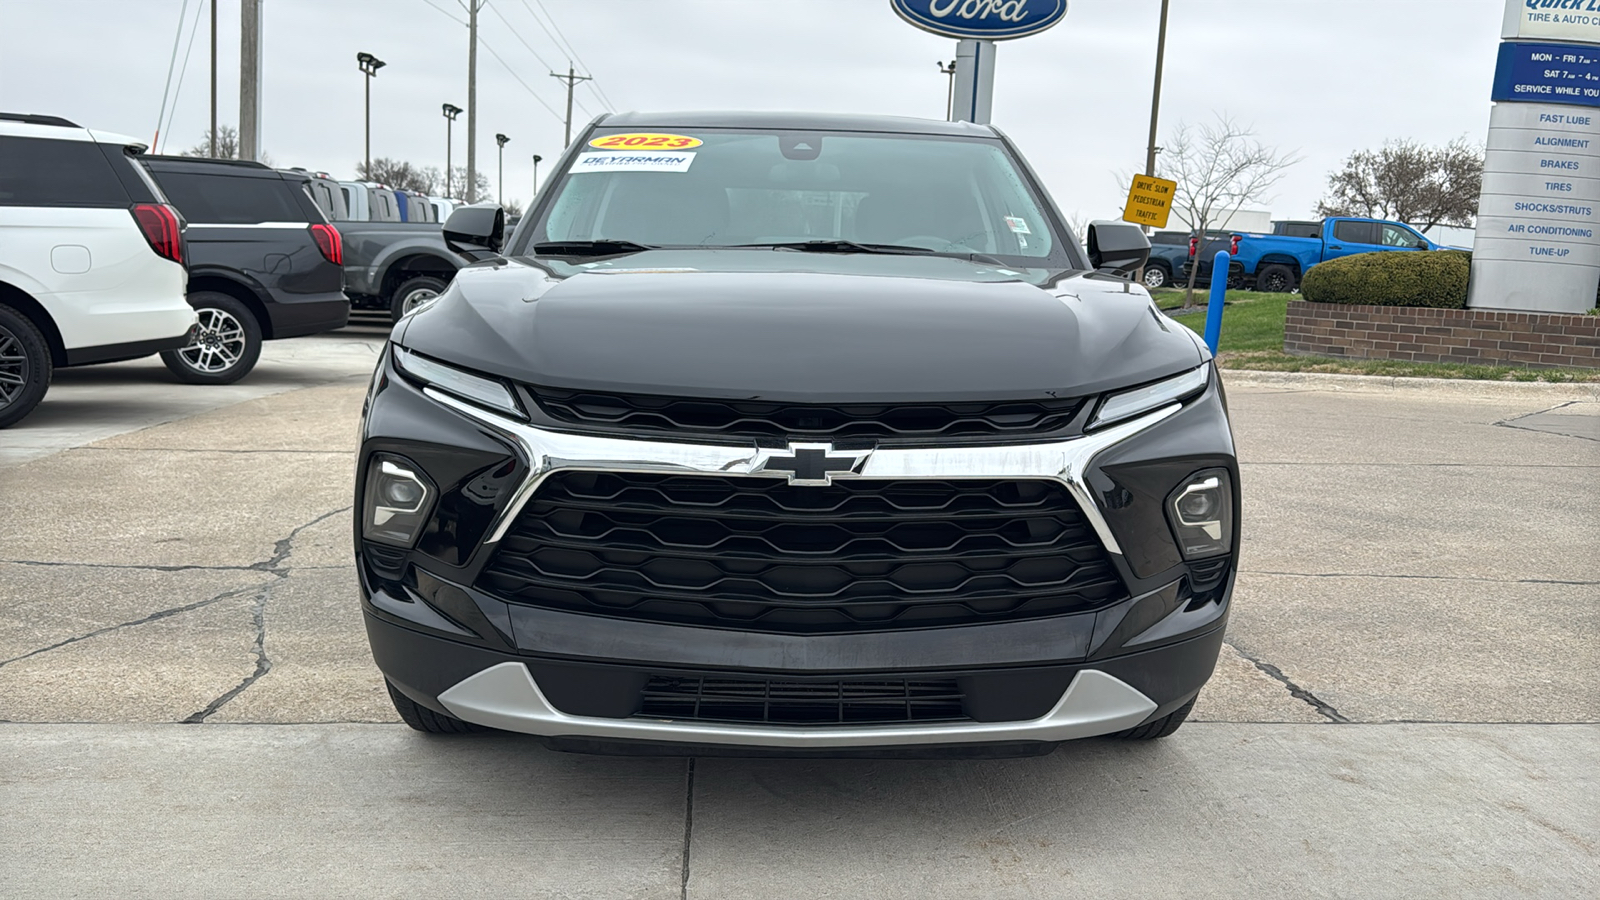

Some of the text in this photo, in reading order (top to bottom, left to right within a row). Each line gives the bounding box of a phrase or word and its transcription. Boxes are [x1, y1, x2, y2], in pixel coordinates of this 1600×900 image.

[1585, 0, 1600, 11] L
[1527, 13, 1600, 26] TIRE & AUTO C
[1531, 53, 1552, 61] MON
[1562, 54, 1576, 63] FRI
[1544, 70, 1560, 78] SAT
[1514, 84, 1600, 97] SERVICE WHILE YOU
[1540, 114, 1591, 125] FAST LUBE
[599, 136, 693, 147] 2023
[1534, 136, 1590, 149] ALIGNMENT
[582, 156, 687, 164] DEYARMAN
[1540, 159, 1579, 170] BRAKES
[1136, 181, 1169, 194] DRIVE SLOW
[1545, 182, 1572, 192] TIRES
[1133, 194, 1166, 207] PEDESTRIAN
[1136, 209, 1157, 220] TRAFFIC
[1514, 202, 1592, 216] SHOCKS/STRUTS
[1508, 224, 1592, 237] AIR CONDITIONING
[1529, 246, 1570, 257] TUNE-UP
